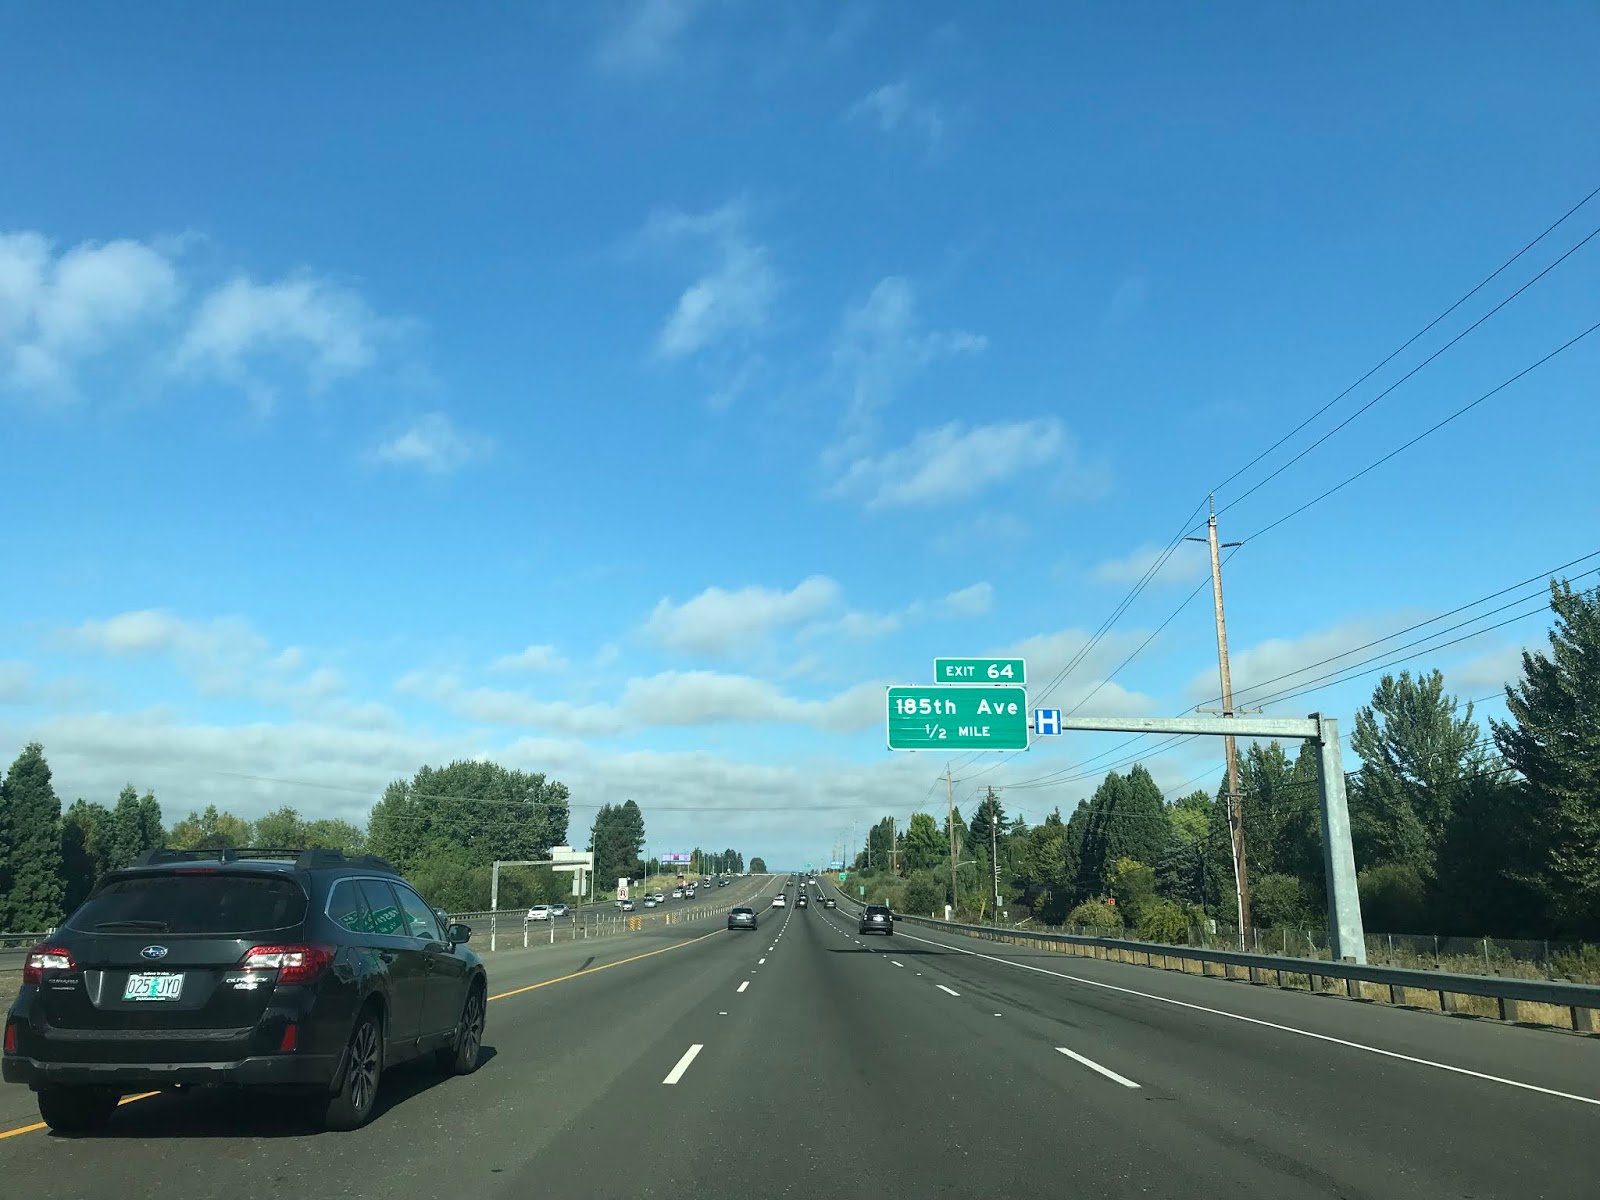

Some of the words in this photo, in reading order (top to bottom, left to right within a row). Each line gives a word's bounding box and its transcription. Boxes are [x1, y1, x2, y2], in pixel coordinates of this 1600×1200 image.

[946, 666, 975, 677] EXIT
[987, 664, 1014, 679] 64
[896, 698, 957, 715] 185th
[976, 699, 1018, 715] Ave
[1037, 710, 1059, 735] H
[958, 726, 991, 737] MILE
[128, 979, 151, 994] 025
[157, 979, 180, 994] JYD
